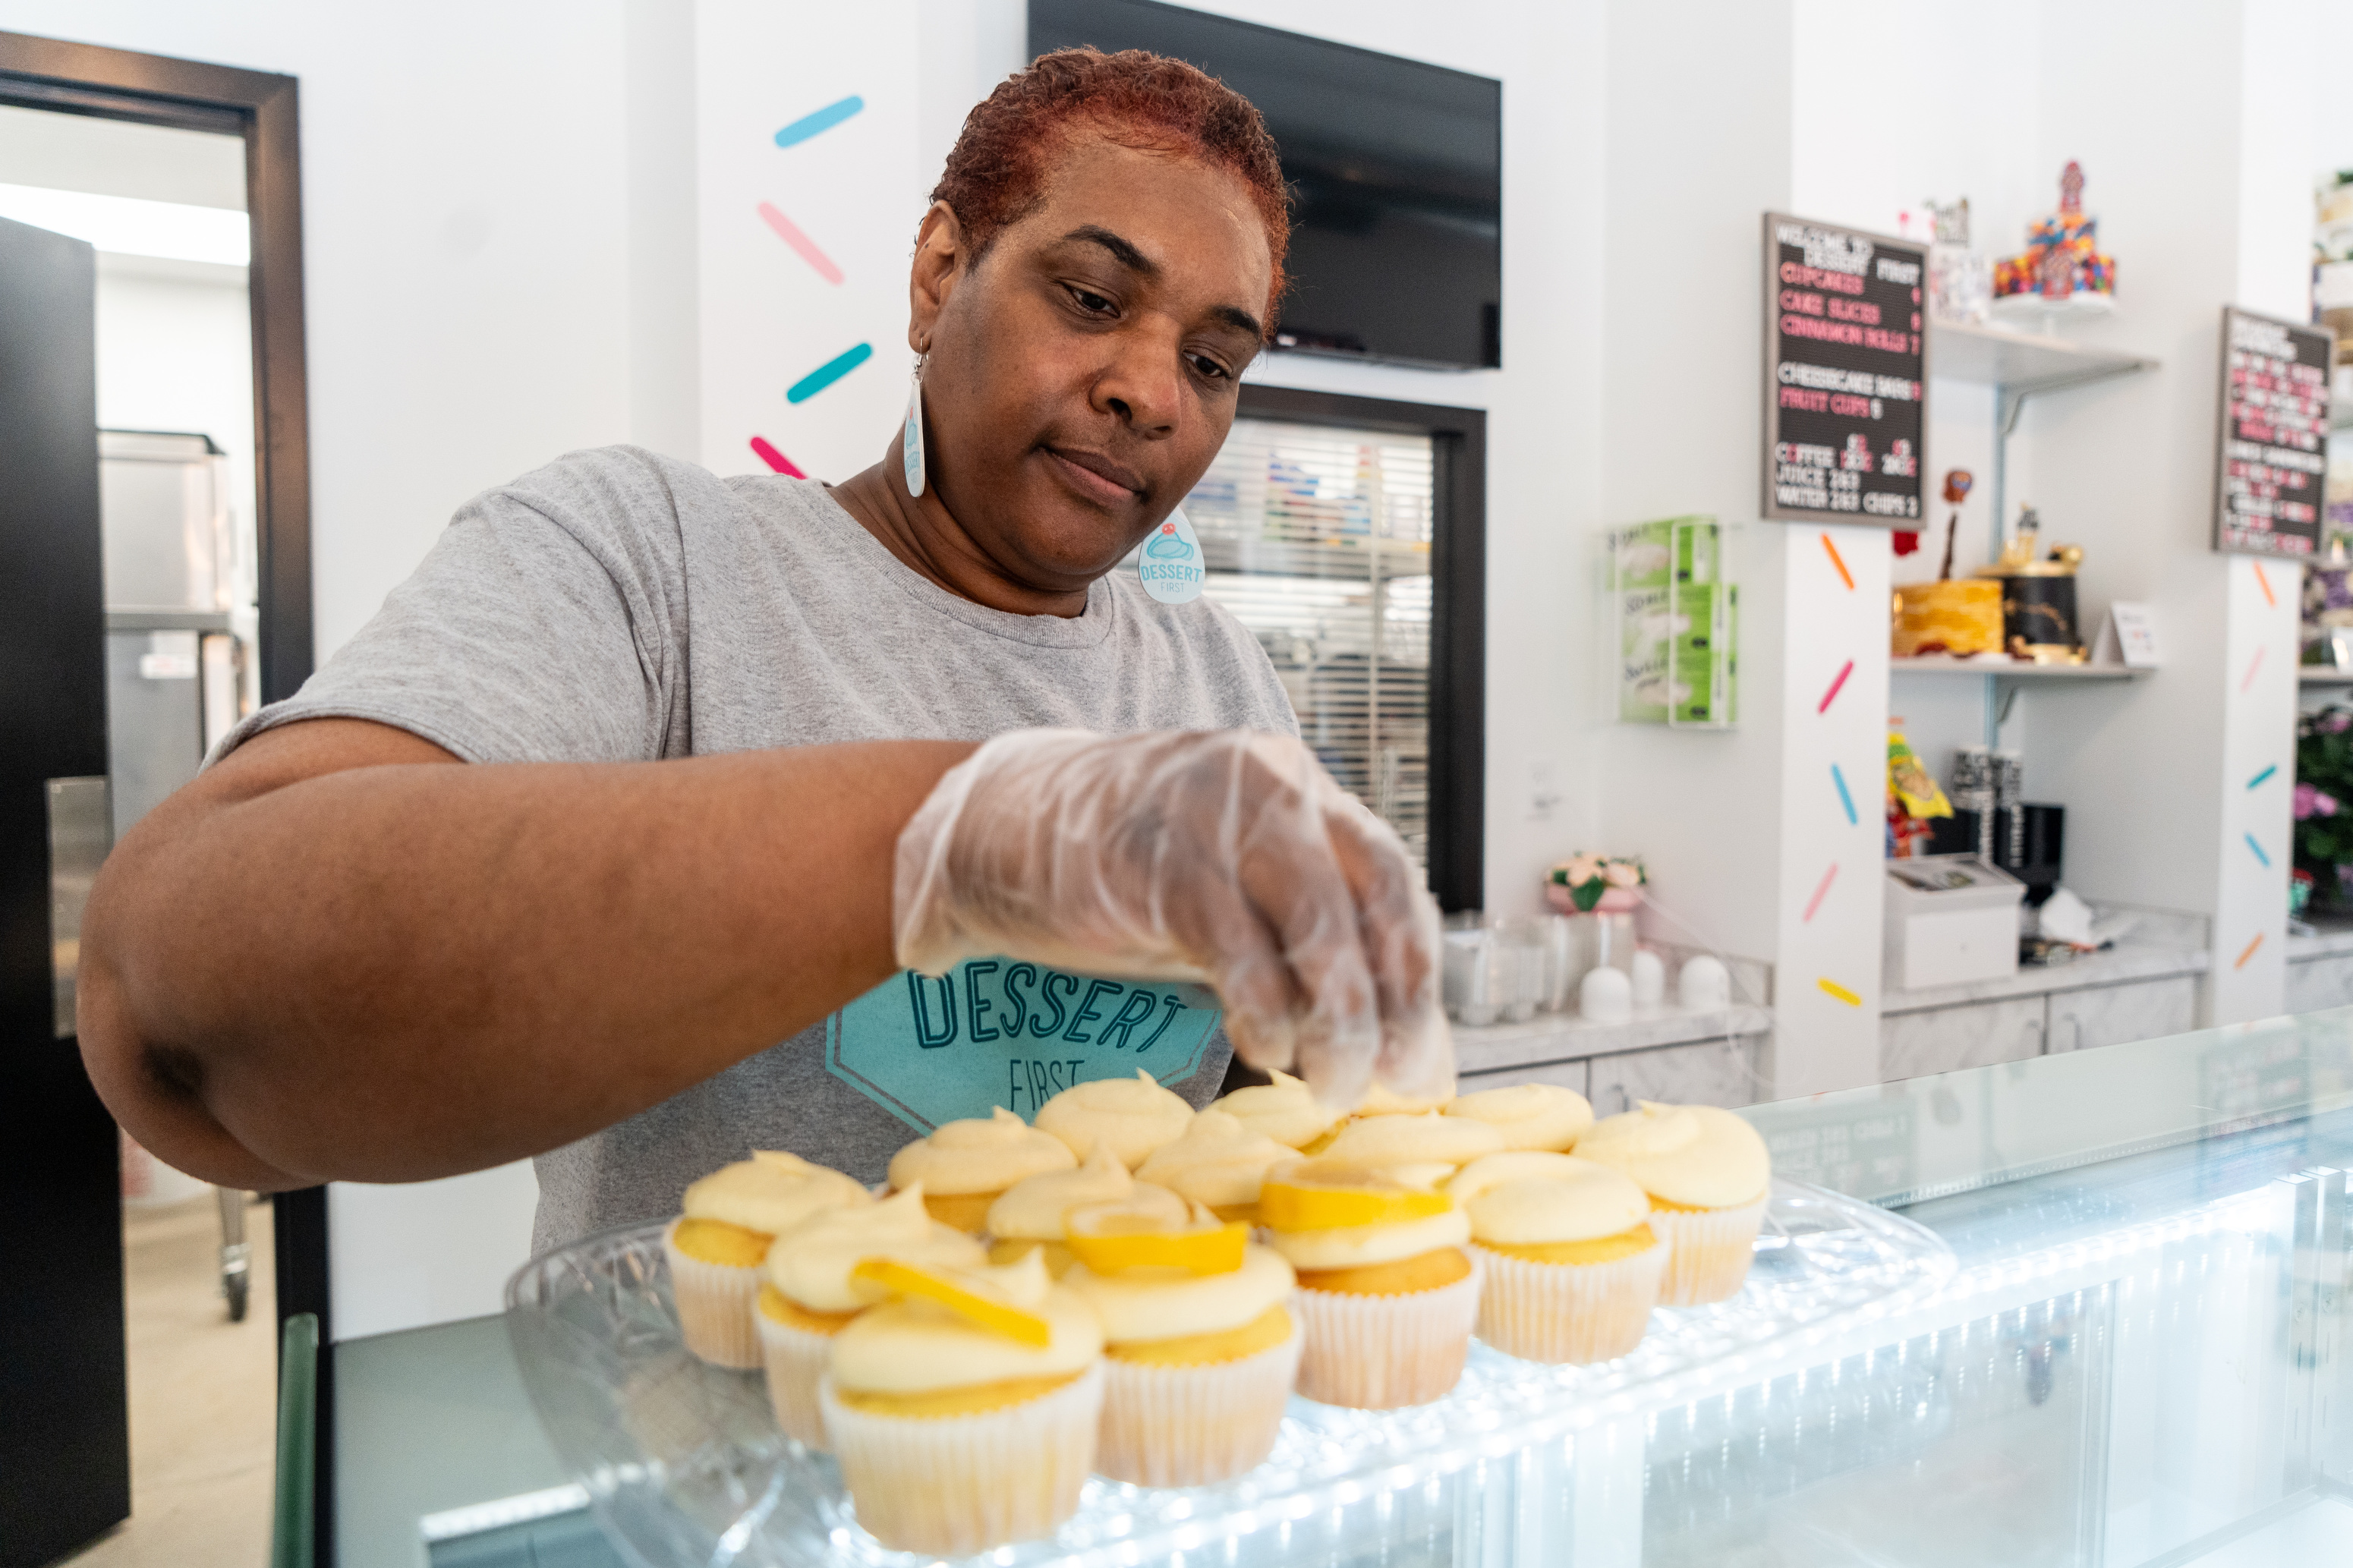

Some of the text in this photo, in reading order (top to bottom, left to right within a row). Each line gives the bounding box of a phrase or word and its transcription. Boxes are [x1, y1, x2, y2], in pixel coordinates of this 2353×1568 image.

[1776, 224, 1847, 250] WELCOME
[1781, 261, 1863, 294] CUPCAKES
[1877, 258, 1920, 284] FIRST
[1780, 289, 1823, 316] CAKE
[1828, 298, 1881, 325] SLICES
[1780, 313, 1863, 345] CINNAMON
[1864, 326, 1908, 353] ROLLS
[1778, 361, 1874, 395] CHEESECAKE
[1876, 376, 1912, 400] BARS
[1780, 386, 1829, 412] FRUIT
[1829, 394, 1870, 418] CUPS
[1775, 442, 1835, 468] COFFEE
[1775, 465, 1824, 488] JUICE
[1775, 485, 1827, 509] WATER
[1863, 491, 1906, 516] CHIPS
[1139, 563, 1202, 584] DESSERT
[1161, 581, 1184, 594] FIRST
[908, 961, 1187, 1053] DESSERT
[1010, 1060, 1085, 1113] FIRST
